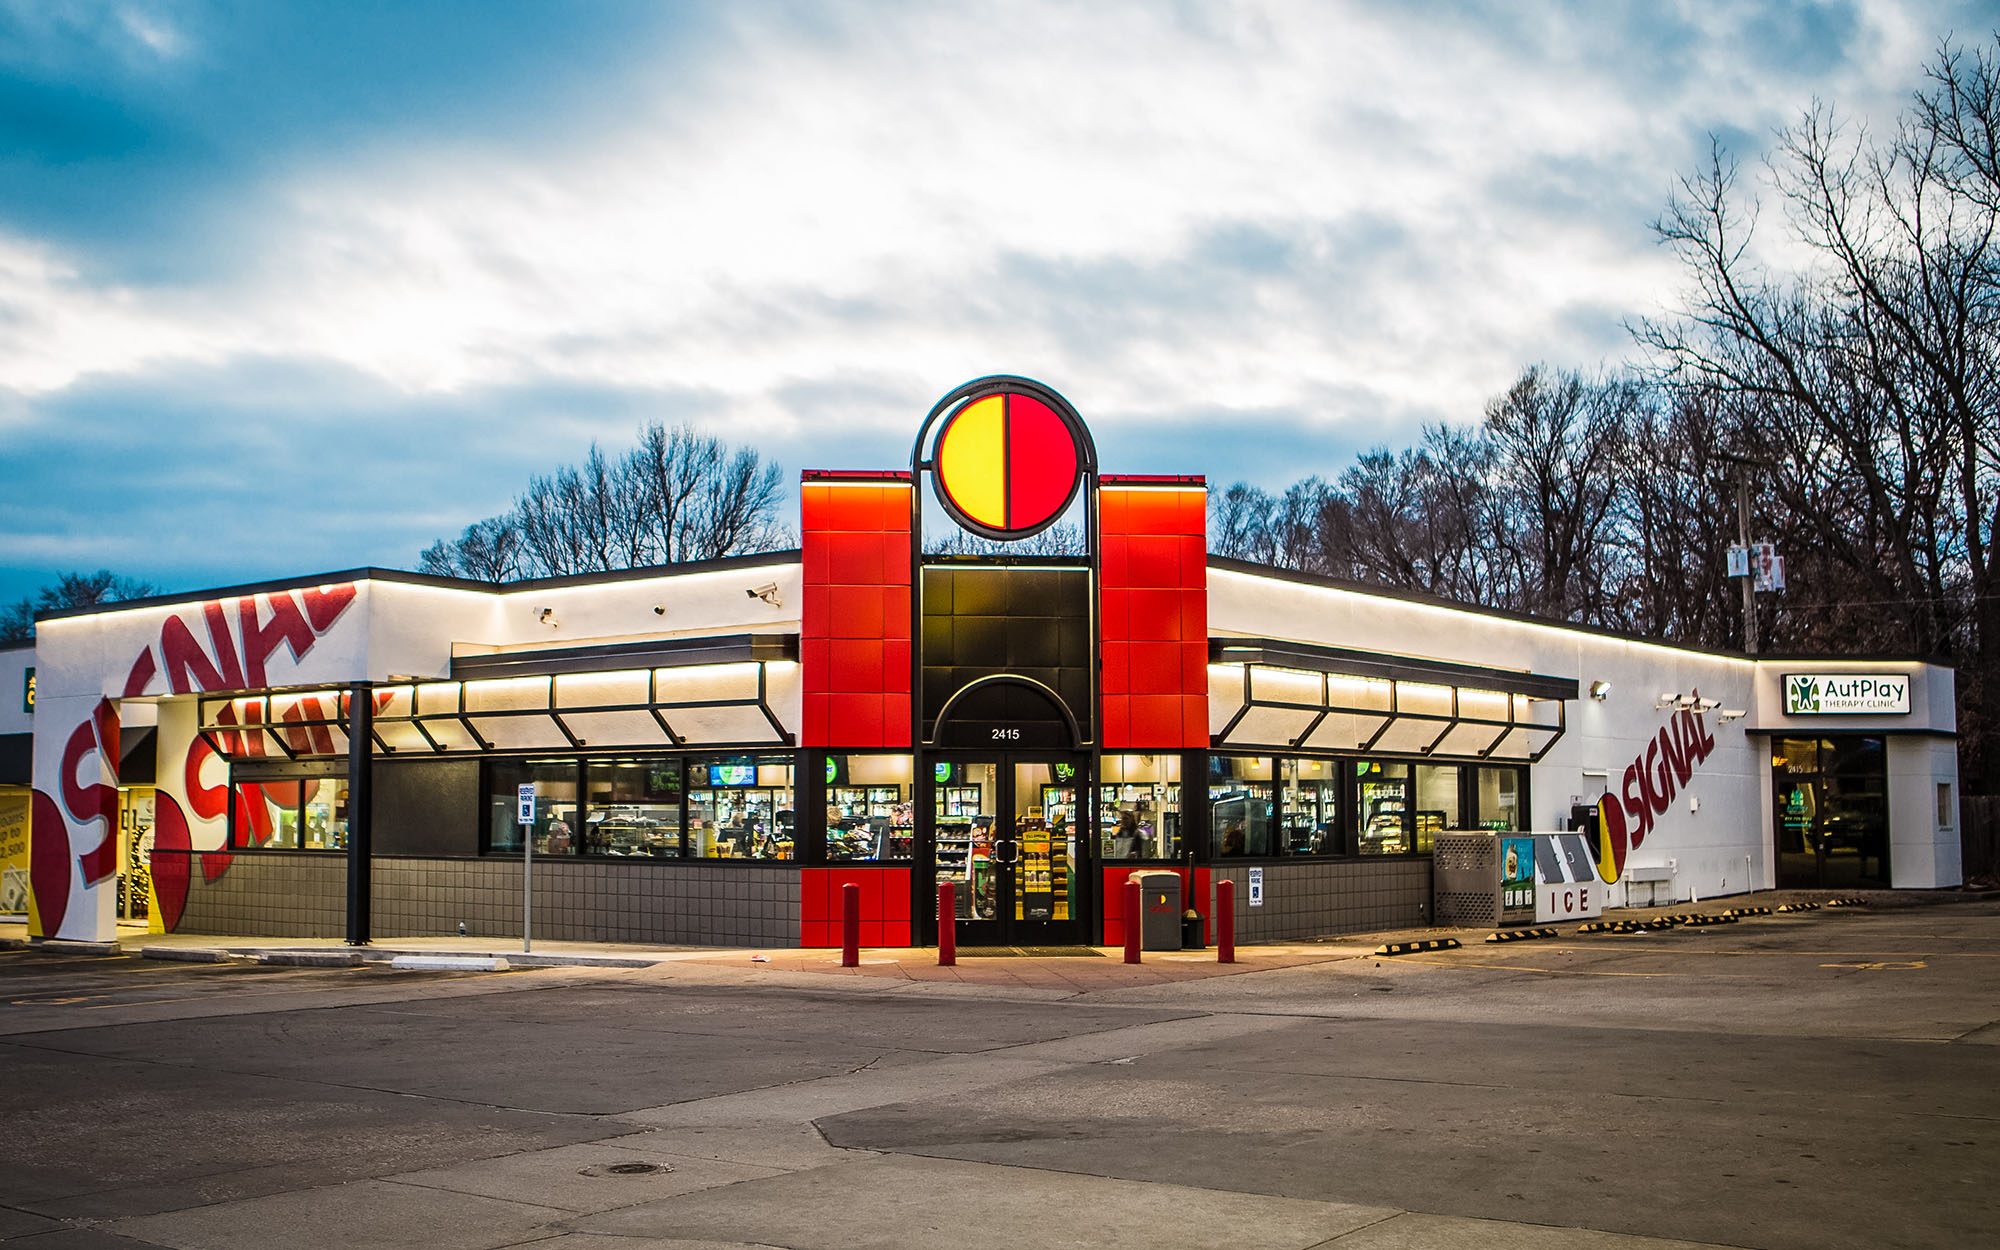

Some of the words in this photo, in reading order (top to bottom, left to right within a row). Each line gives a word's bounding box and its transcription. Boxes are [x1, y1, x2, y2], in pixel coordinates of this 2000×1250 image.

[1825, 680, 1904, 702] AutPlay
[1825, 700, 1864, 709] THERAPY
[1867, 700, 1895, 709] CLINIC
[991, 728, 1020, 740] 2415
[1622, 688, 1715, 851] SIGNAL
[1551, 888, 1588, 914] ICE
